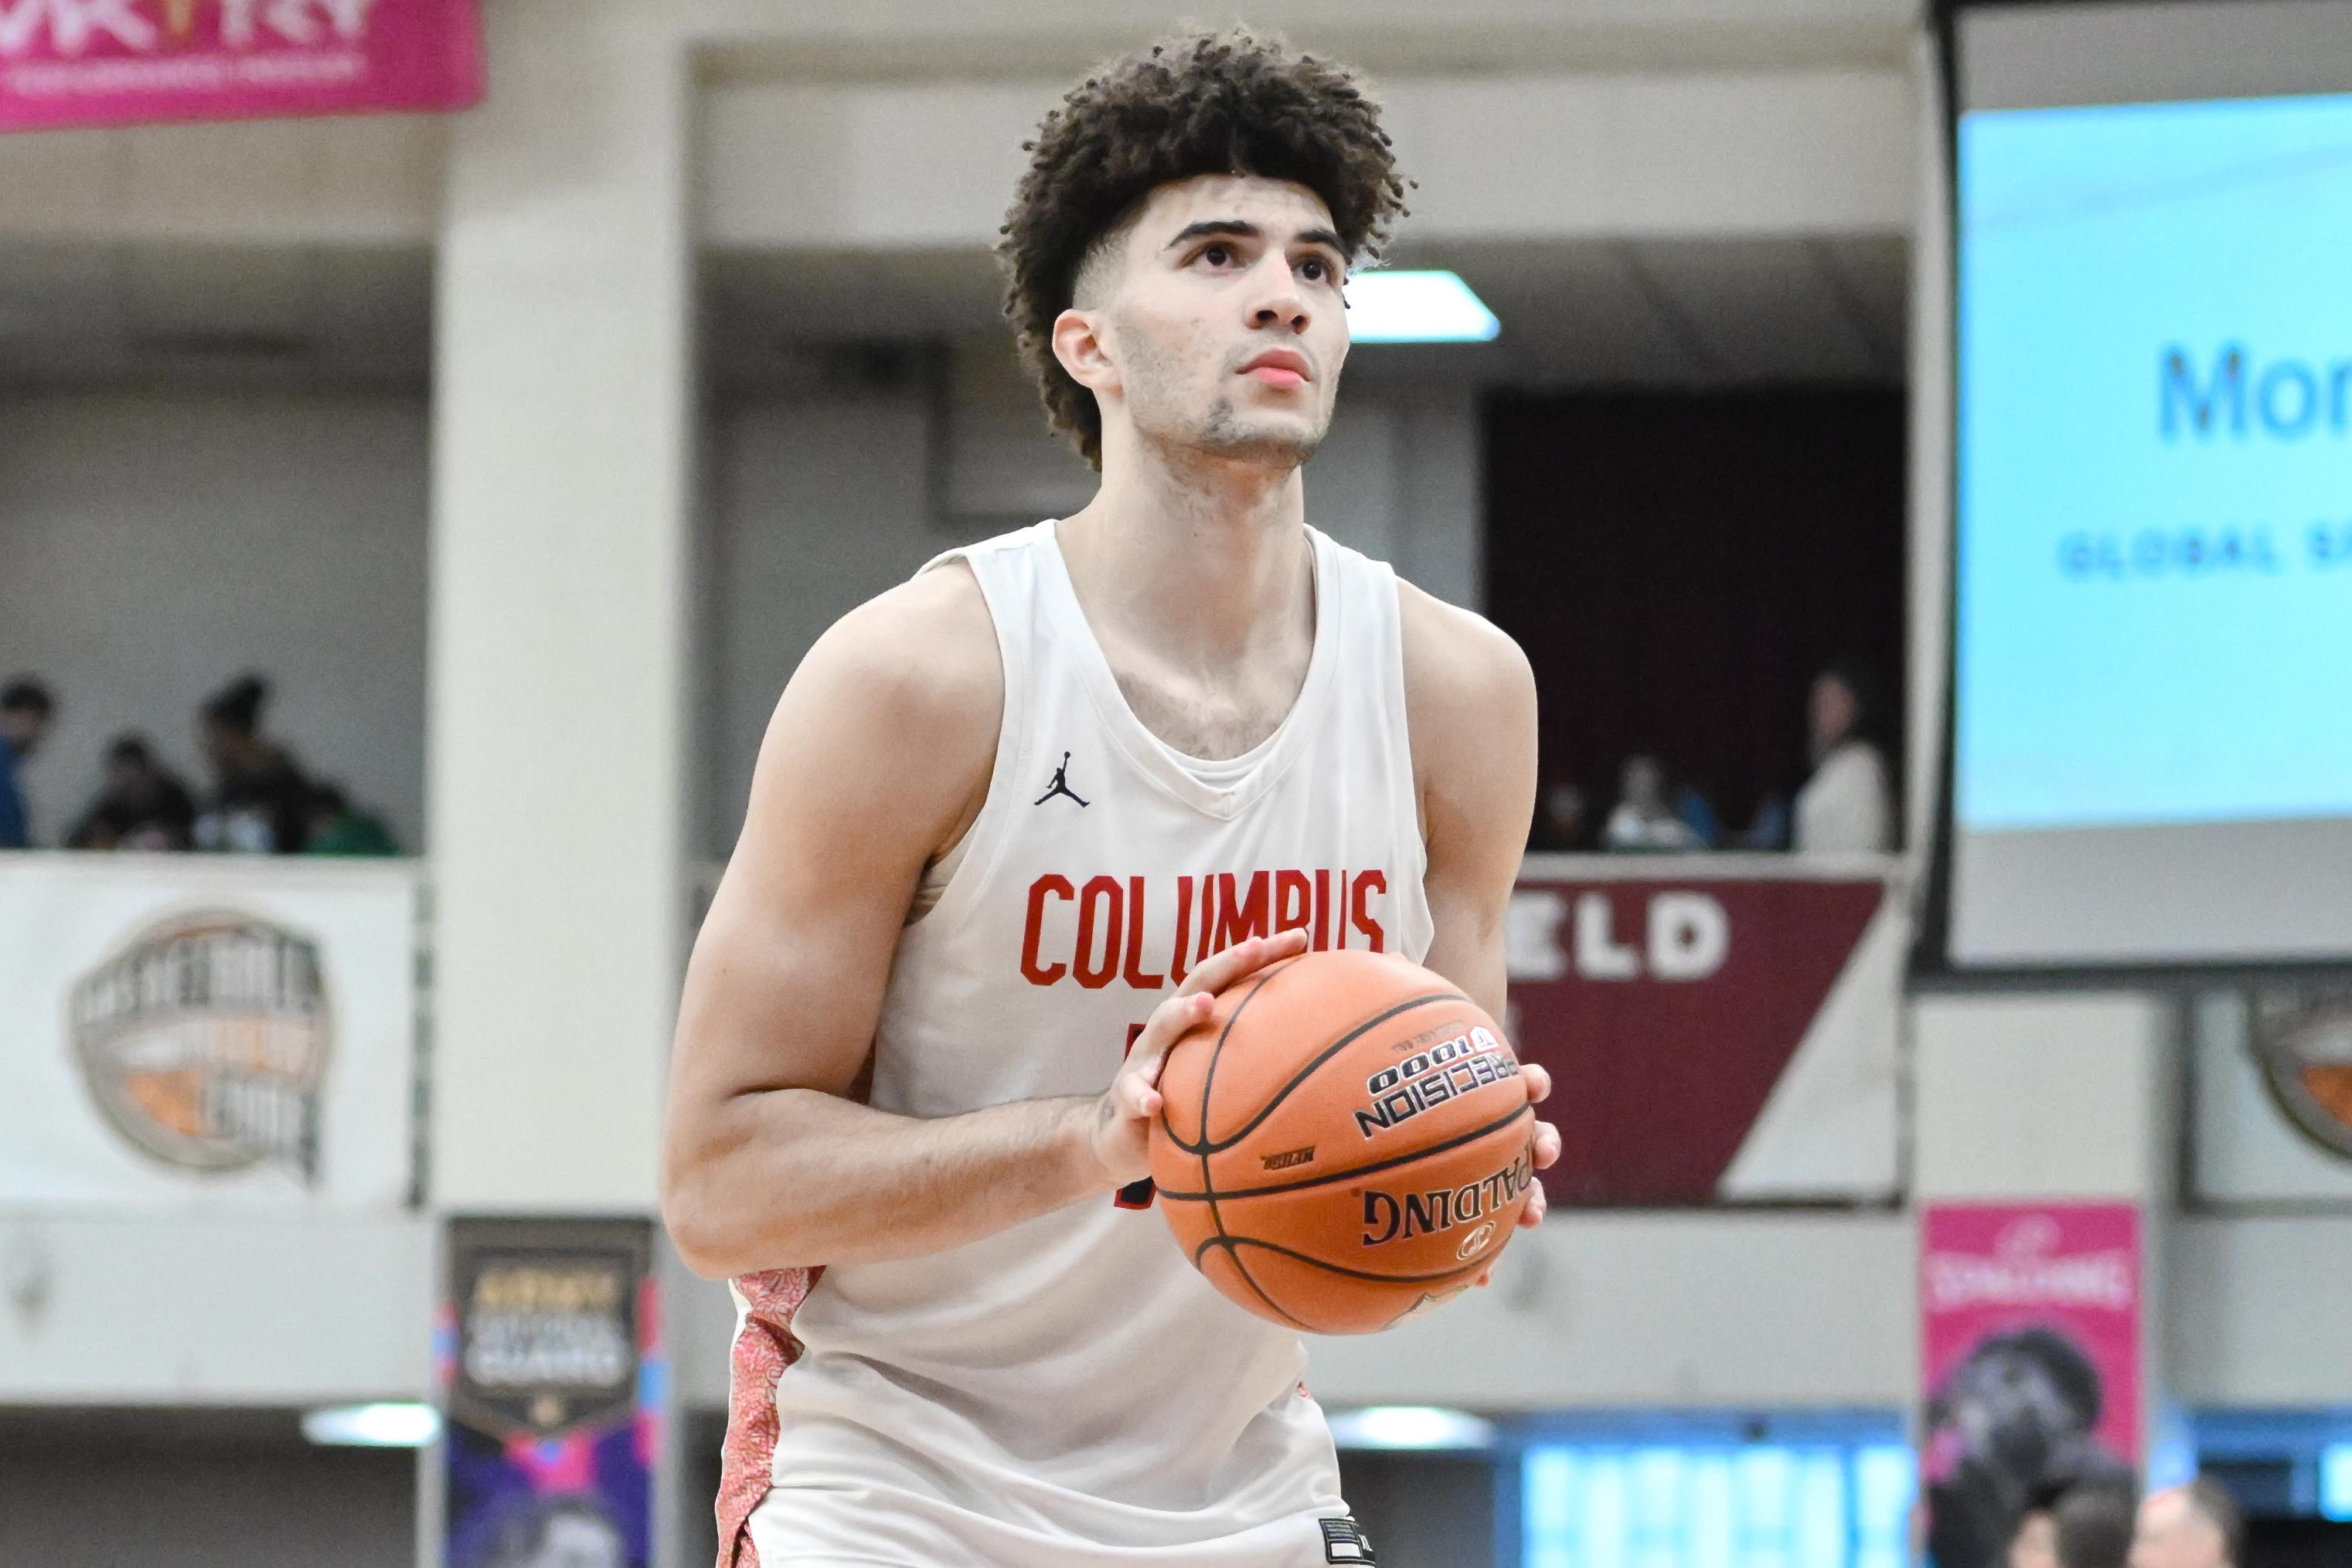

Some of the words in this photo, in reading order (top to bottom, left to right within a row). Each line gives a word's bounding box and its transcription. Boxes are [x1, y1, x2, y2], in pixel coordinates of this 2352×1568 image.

[2056, 529, 2282, 581] GLOBAL
[1506, 889, 1731, 982] ELD
[1362, 1135, 1534, 1247] PALDING
